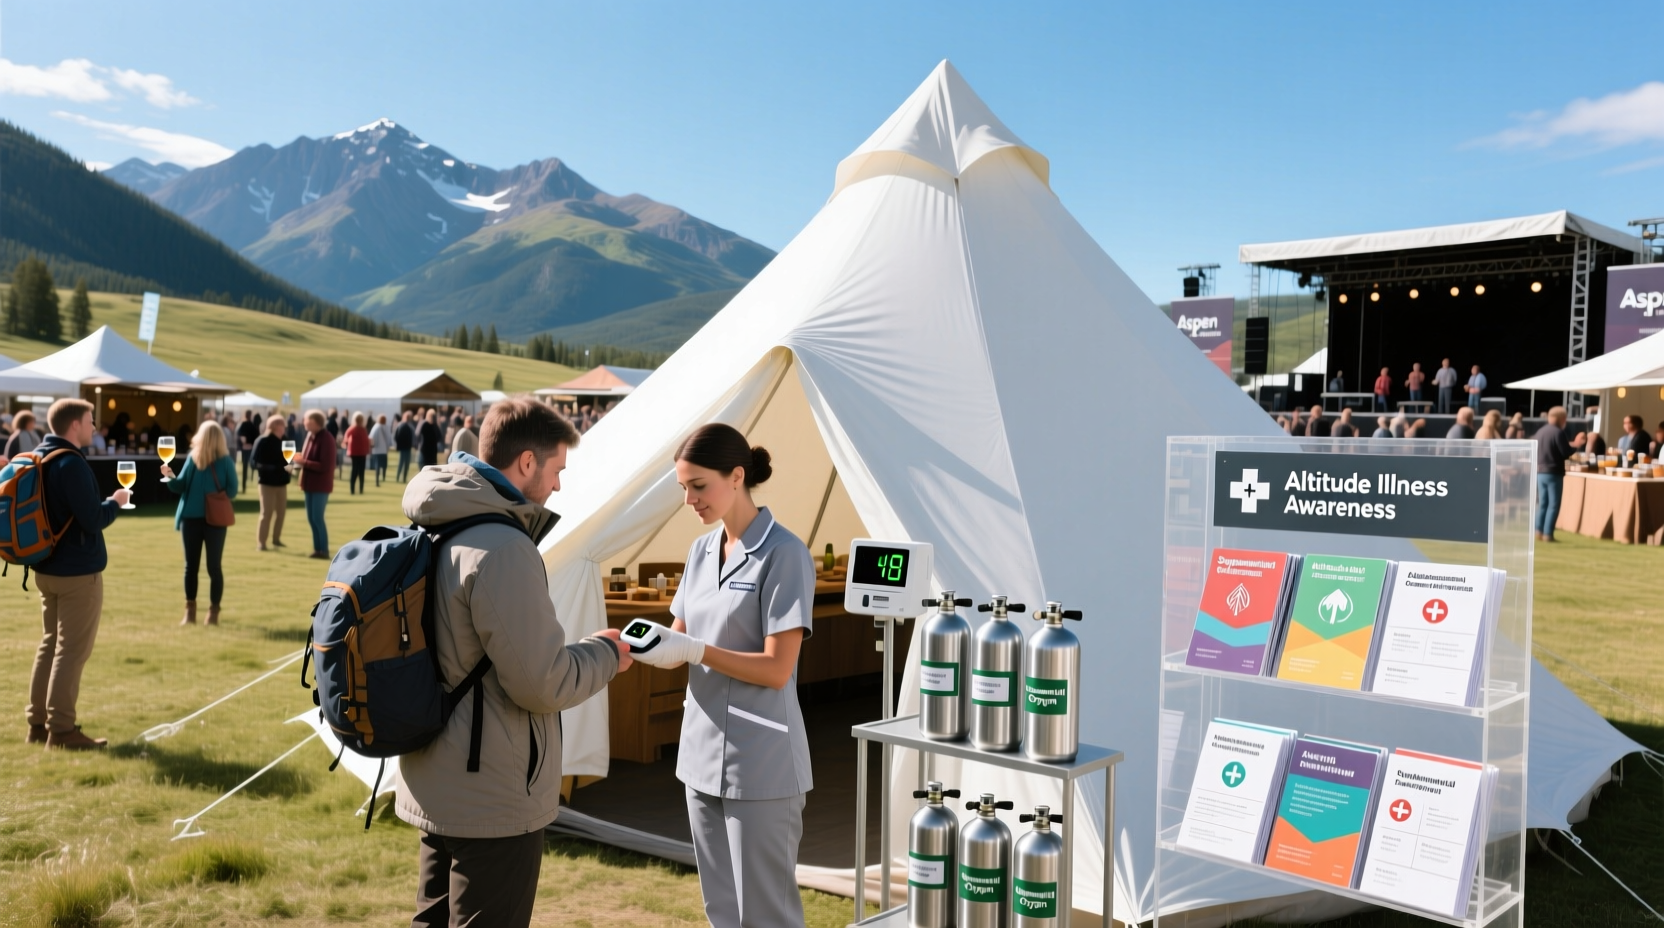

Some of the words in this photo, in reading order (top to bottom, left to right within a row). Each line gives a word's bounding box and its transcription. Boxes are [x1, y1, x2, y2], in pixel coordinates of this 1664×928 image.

[1620, 288, 1664, 317] Asp
[1177, 314, 1218, 338] Aspen
[1284, 470, 1372, 494] Altitude
[1377, 473, 1449, 497] Illness
[1283, 494, 1396, 520] Awareness
[878, 554, 904, 581] 48
